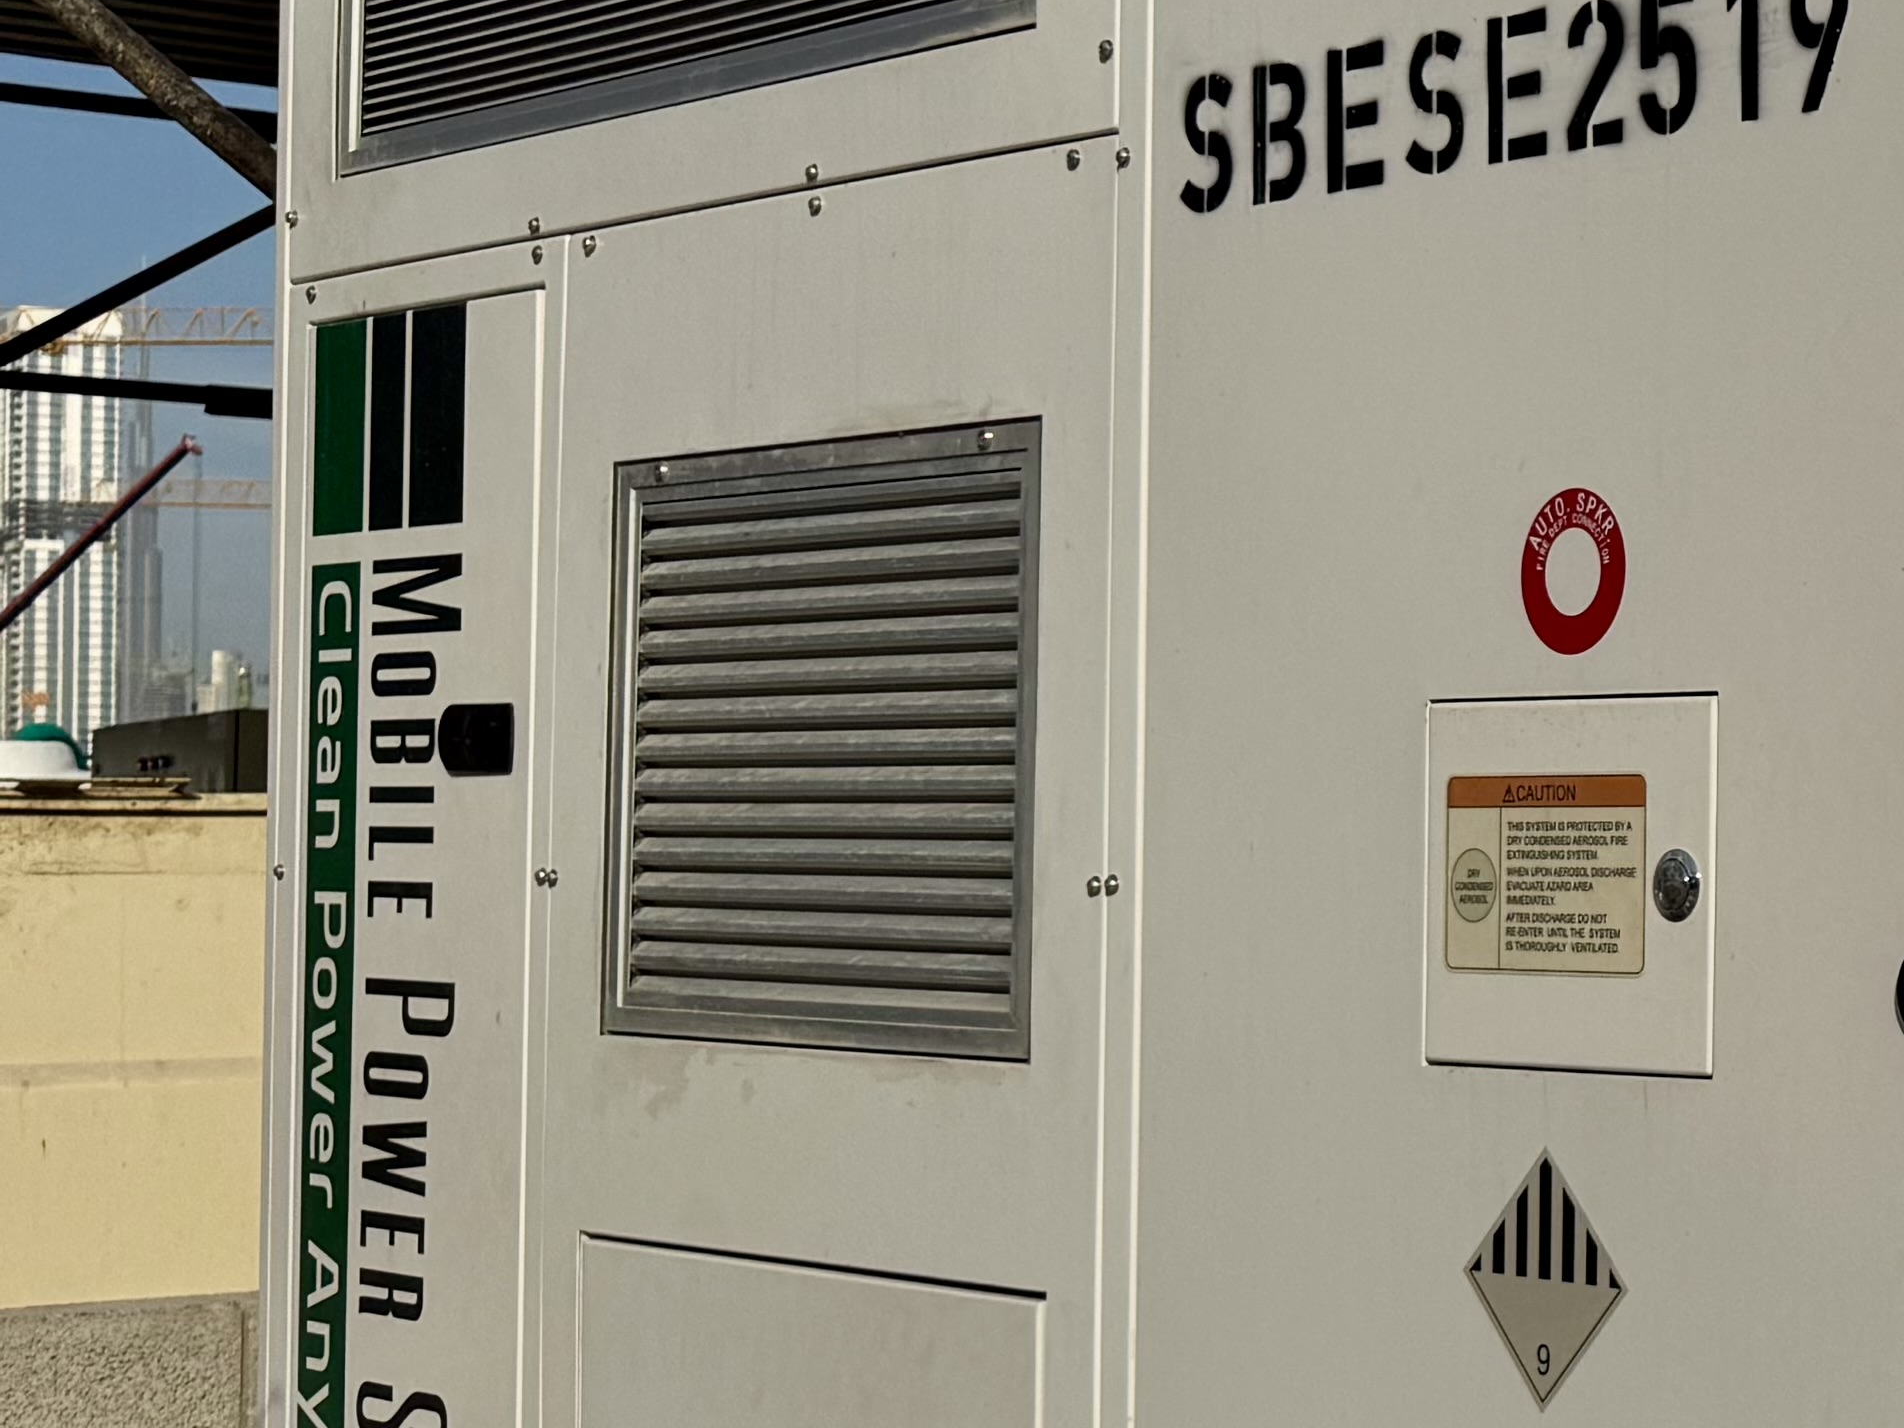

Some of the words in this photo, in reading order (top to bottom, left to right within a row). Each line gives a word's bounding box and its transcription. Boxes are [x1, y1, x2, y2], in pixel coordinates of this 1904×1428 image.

[1536, 539, 1550, 570] FIRE
[1549, 515, 1567, 537] DEPT
[314, 580, 352, 849] Clean
[367, 553, 463, 918] MOBILE
[1516, 785, 1577, 801] CAUTION
[1507, 821, 1524, 831] THIS
[1525, 821, 1556, 831] SYSTEM
[1566, 821, 1613, 831] PROTECTED
[1626, 821, 1632, 831] A
[1524, 835, 1571, 846] CONDENSED
[1572, 835, 1608, 846] AEROSOL
[1610, 835, 1628, 846] FIRE
[1505, 912, 1531, 923] AFTER
[1531, 912, 1576, 924] DISCHARGE
[1577, 913, 1589, 924] DO
[1590, 913, 1607, 924] NOT
[1570, 927, 1585, 938] THE
[1589, 928, 1621, 939] SYSTEM
[1515, 941, 1566, 952] THOROUGHLY
[309, 891, 347, 1209] Power
[358, 977, 456, 1321] POWER
[1537, 1344, 1550, 1375] 9
